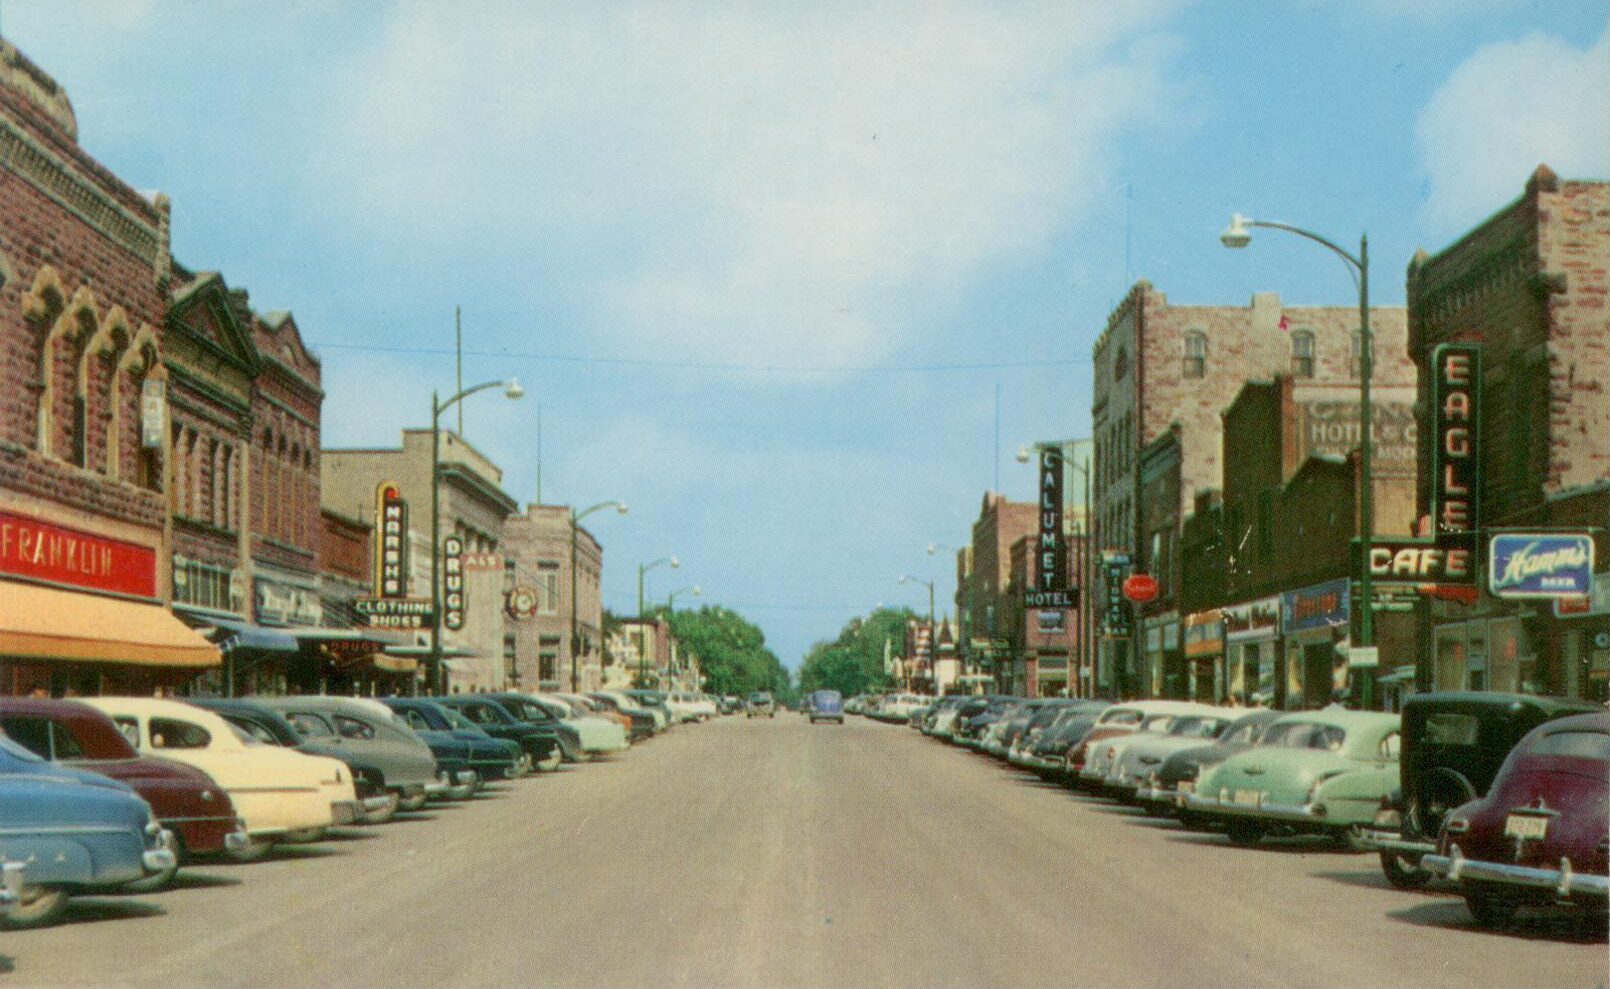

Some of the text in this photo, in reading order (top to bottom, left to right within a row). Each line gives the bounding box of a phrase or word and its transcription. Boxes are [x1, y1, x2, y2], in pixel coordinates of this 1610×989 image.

[1445, 355, 1470, 530] EAGLE
[1043, 452, 1055, 587] CALUMET
[1, 523, 111, 576] FRANKLIN
[1369, 547, 1468, 576] CAFE
[446, 540, 461, 627] DRUGS
[1025, 592, 1071, 605] HOTEL
[1541, 577, 1575, 589] BEER
